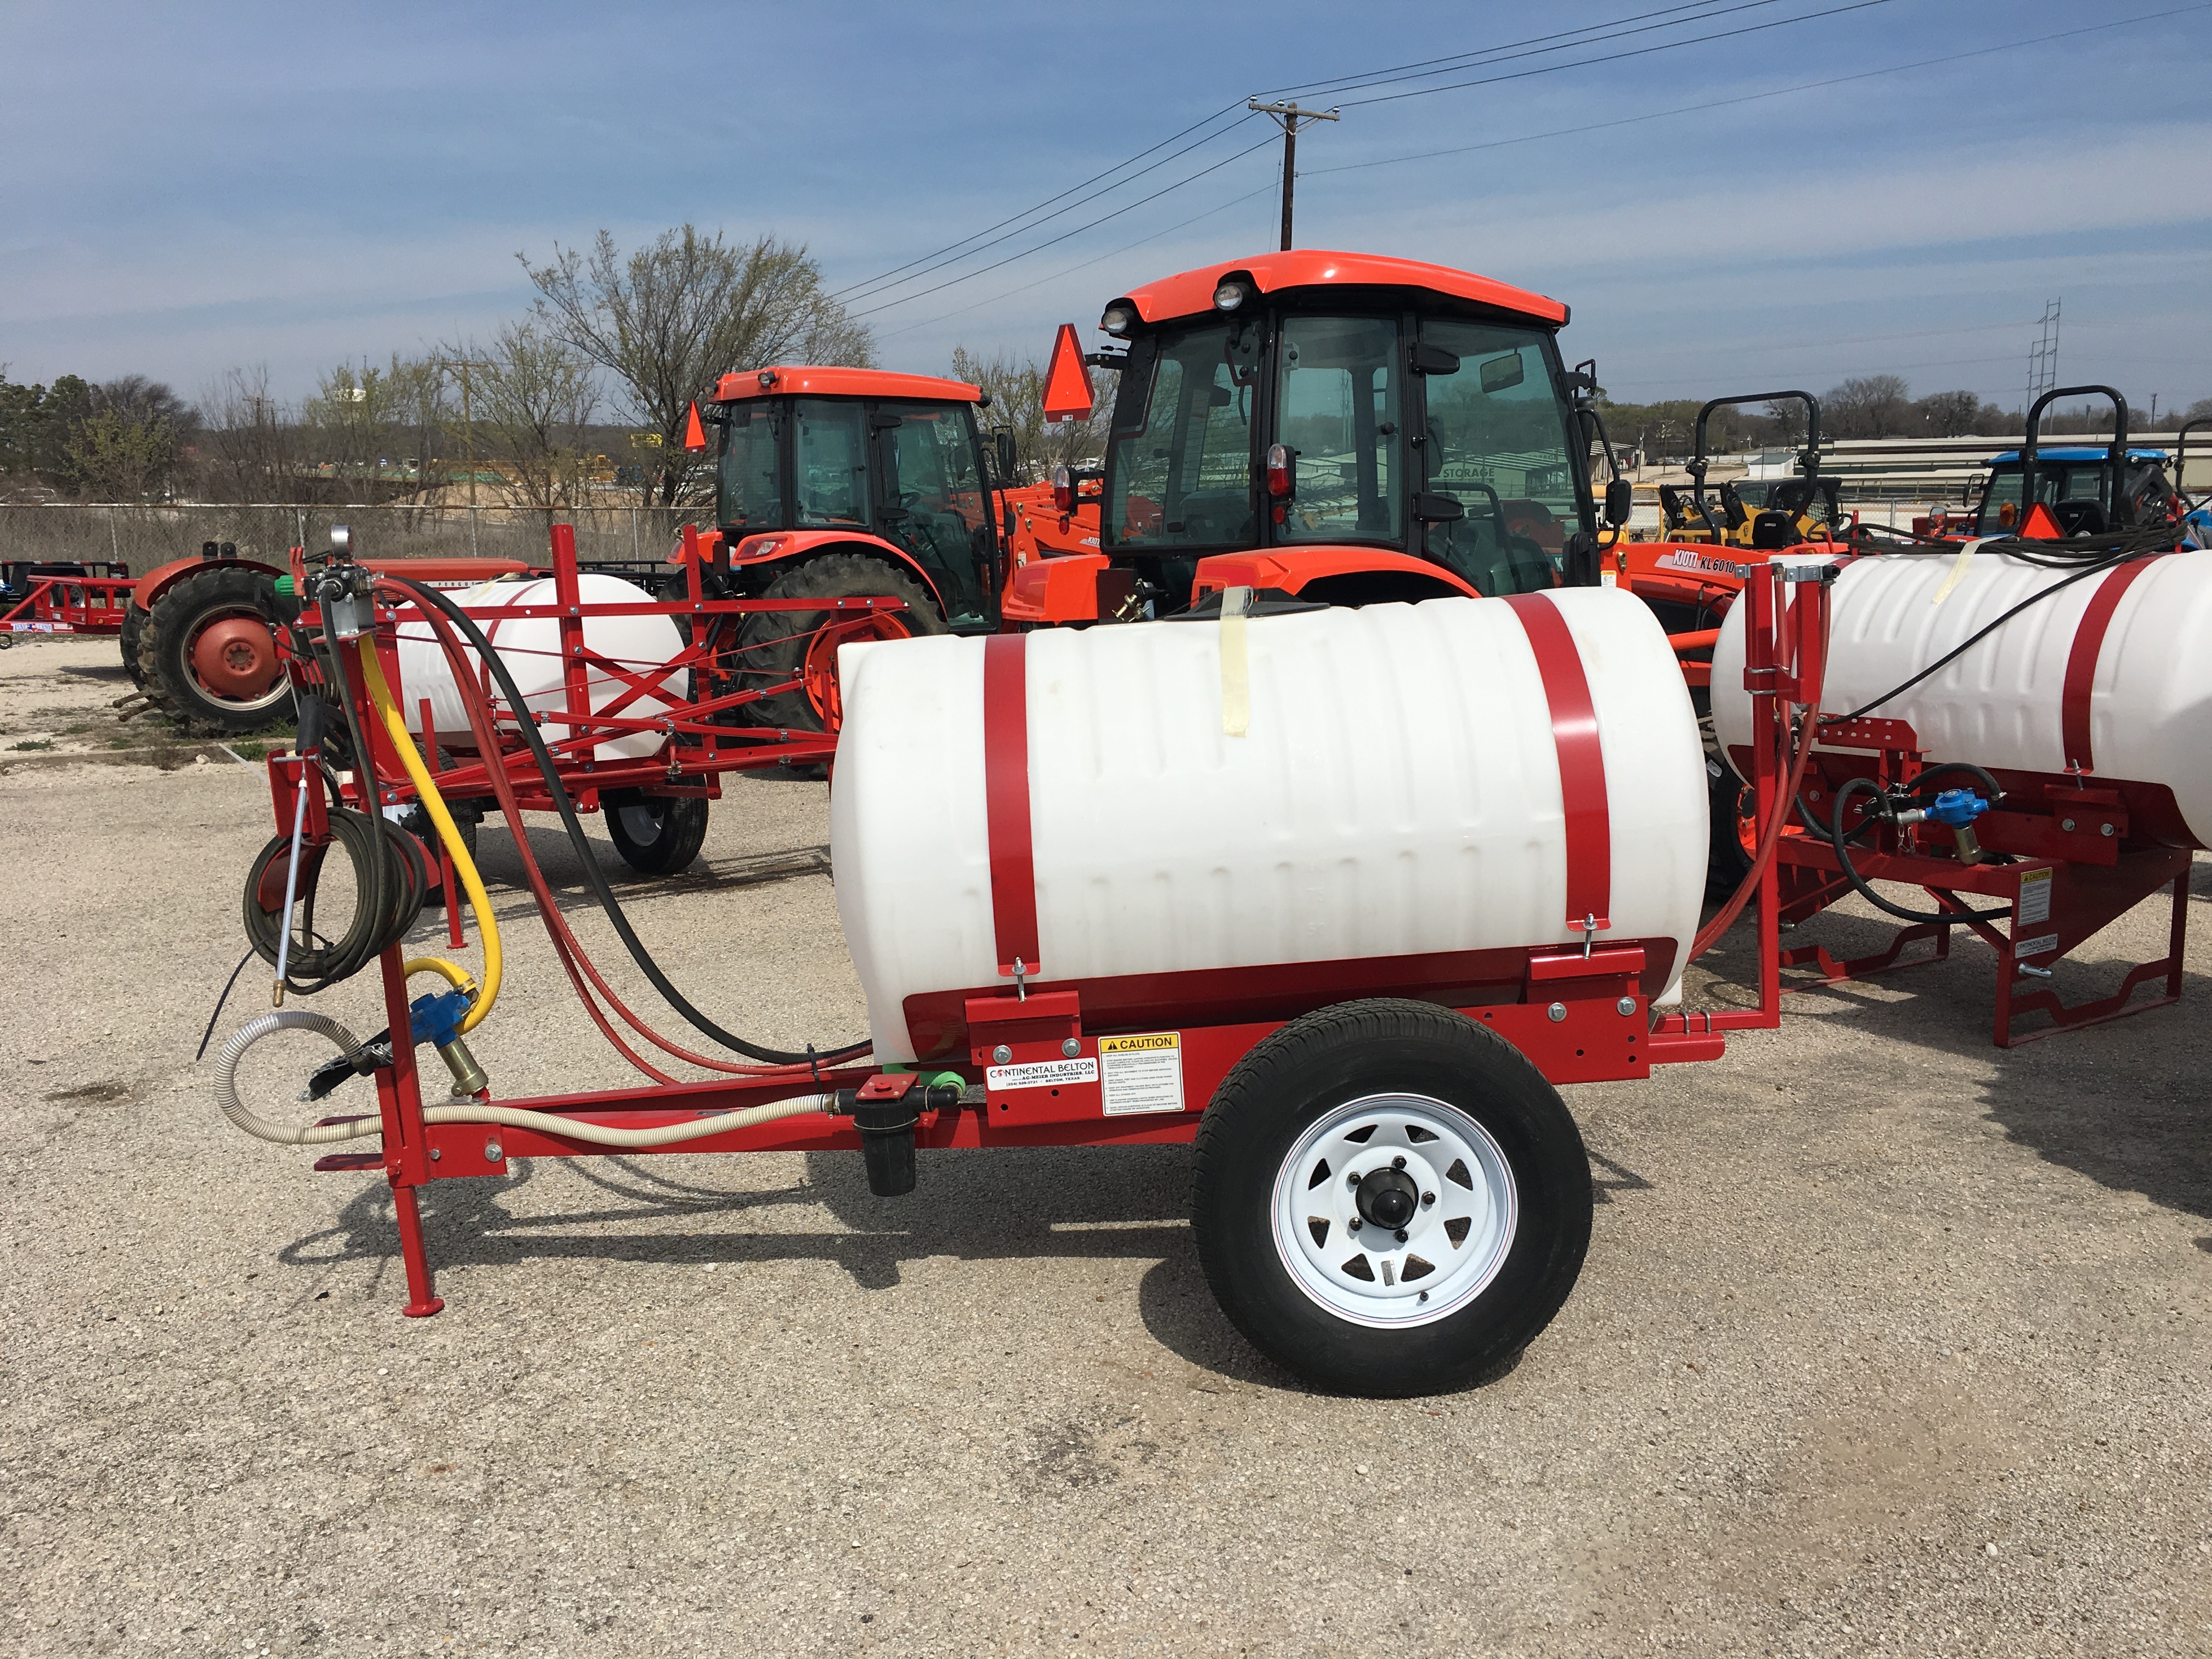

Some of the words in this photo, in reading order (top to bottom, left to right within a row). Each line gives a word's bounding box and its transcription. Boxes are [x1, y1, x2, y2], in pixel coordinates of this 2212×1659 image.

[1443, 467, 1494, 478] STORAGE
[1088, 536, 1100, 545] KIOT
[1673, 549, 1699, 568] KIOTI
[2029, 871, 2050, 881] CAUTION
[1120, 1037, 1172, 1049] CAUTION
[1058, 1061, 1094, 1073] BELTON
